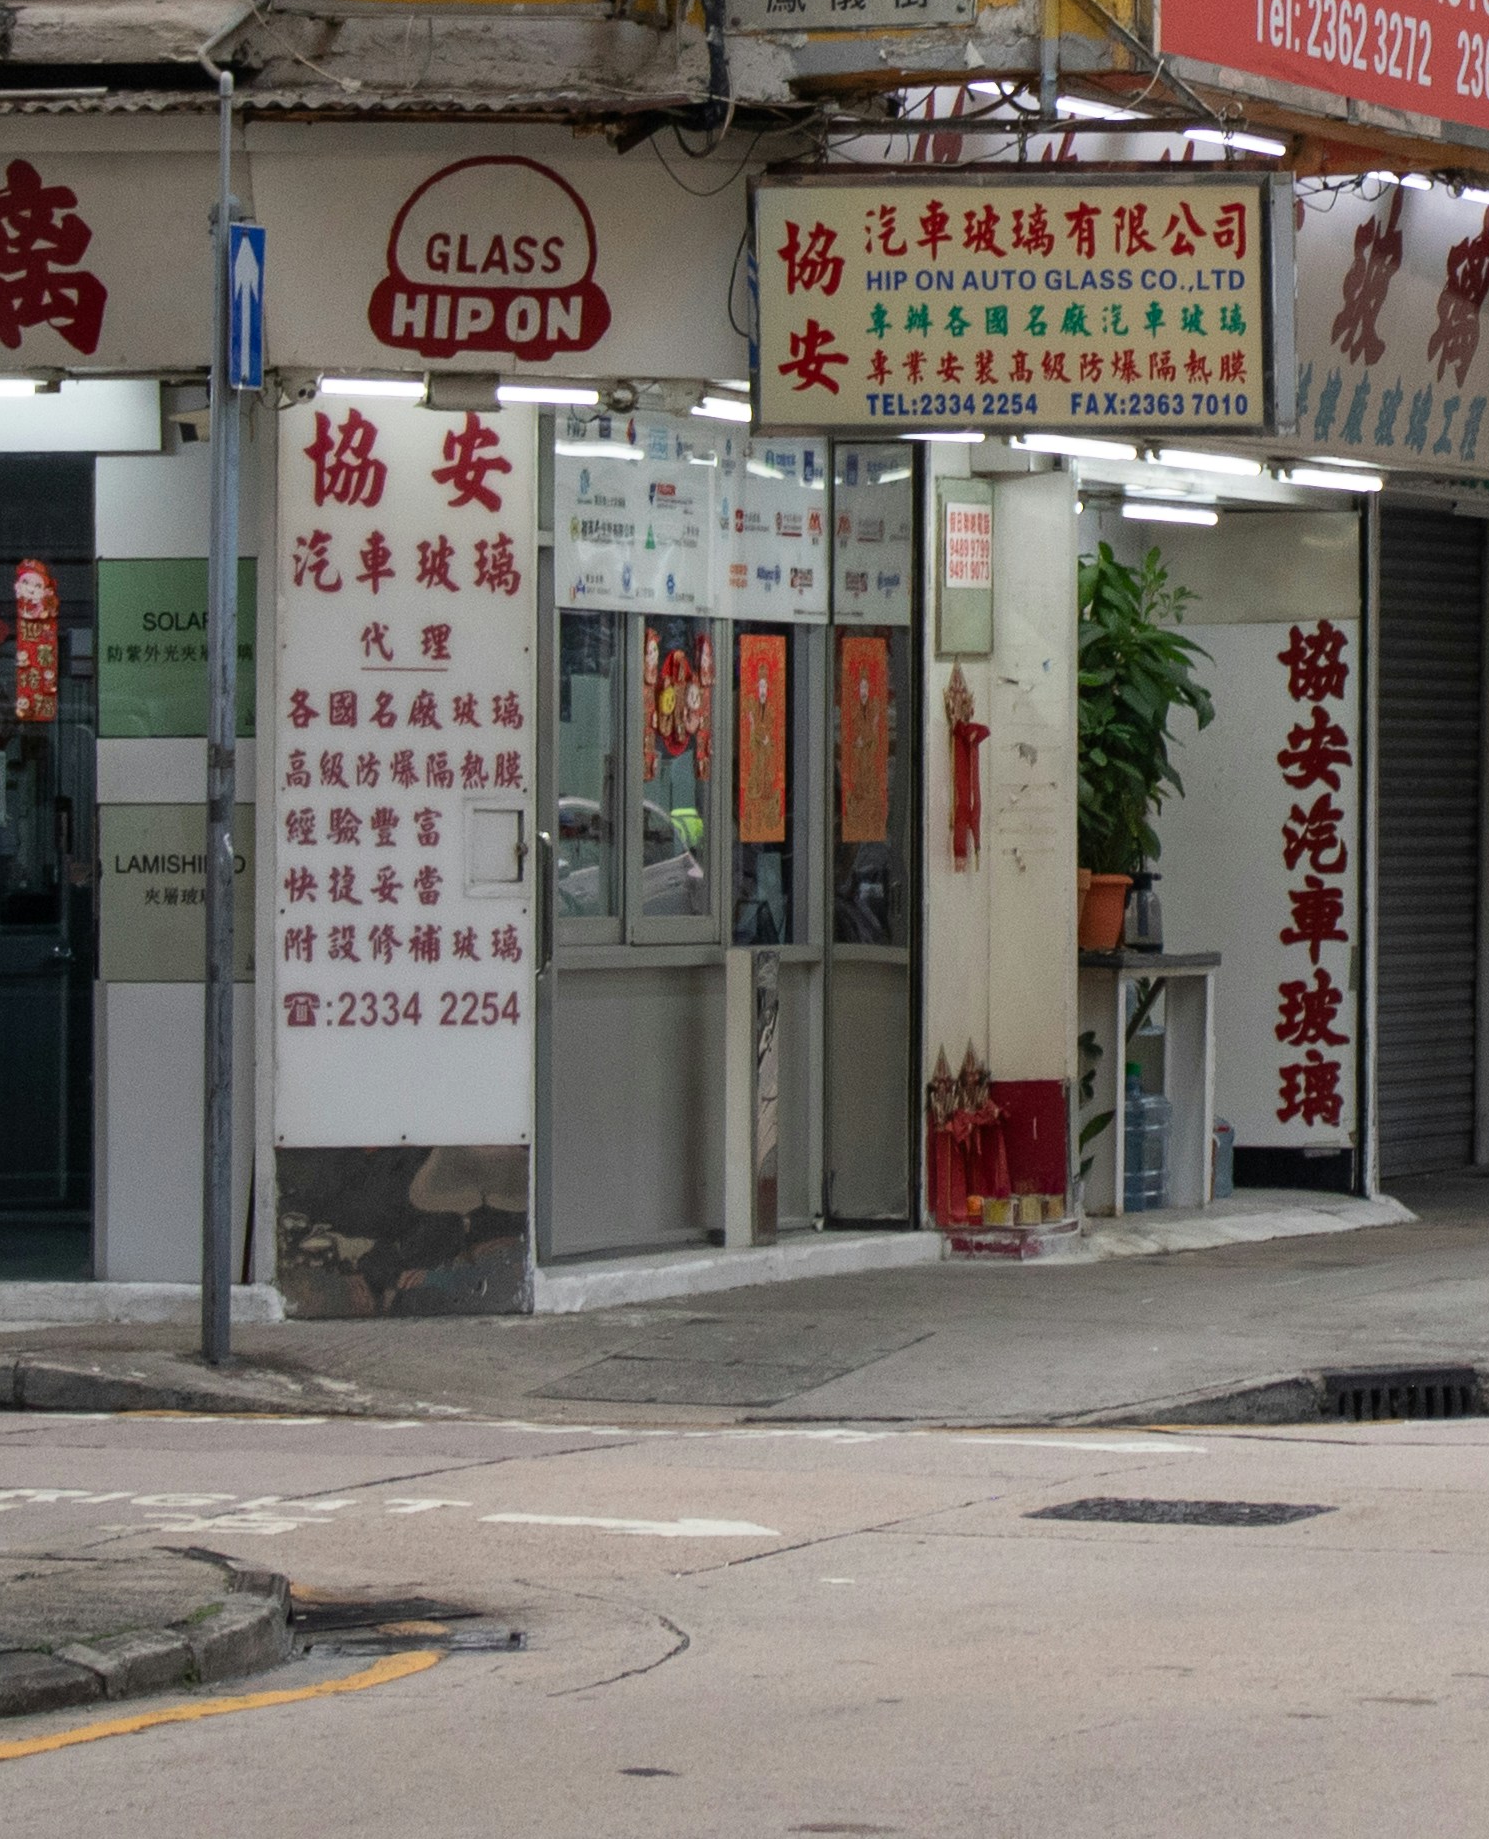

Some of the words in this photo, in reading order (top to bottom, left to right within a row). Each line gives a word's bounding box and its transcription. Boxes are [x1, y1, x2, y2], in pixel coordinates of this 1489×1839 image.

[1373, 4, 1433, 87] 3272
[864, 200, 1248, 262] 汽車玻璃有限公司
[425, 231, 565, 275] GLASS
[866, 269, 910, 293] HIP
[916, 270, 955, 292] ON
[961, 270, 1038, 292] AUTO
[1044, 270, 1135, 293] GLASS
[1140, 270, 1246, 295] CO.,LTD
[391, 292, 496, 342] HIP
[505, 294, 584, 343] ON
[777, 220, 850, 396] 協安
[981, 393, 1038, 416] 2254
[1192, 393, 1248, 416] 7010
[305, 406, 512, 513] 協安
[291, 530, 523, 597] 汽車玻璃
[361, 622, 452, 662] 代理
[288, 689, 525, 730] 各國名廠玻璃
[285, 750, 523, 790] 高級防爆隔熱膜
[285, 807, 442, 848] 經驗豐富
[284, 866, 445, 906] 快捷妥當
[1278, 619, 1352, 1128] 協安汽車玻璃
[284, 924, 523, 964] 附設修補玻璃
[440, 991, 521, 1027] 2254
